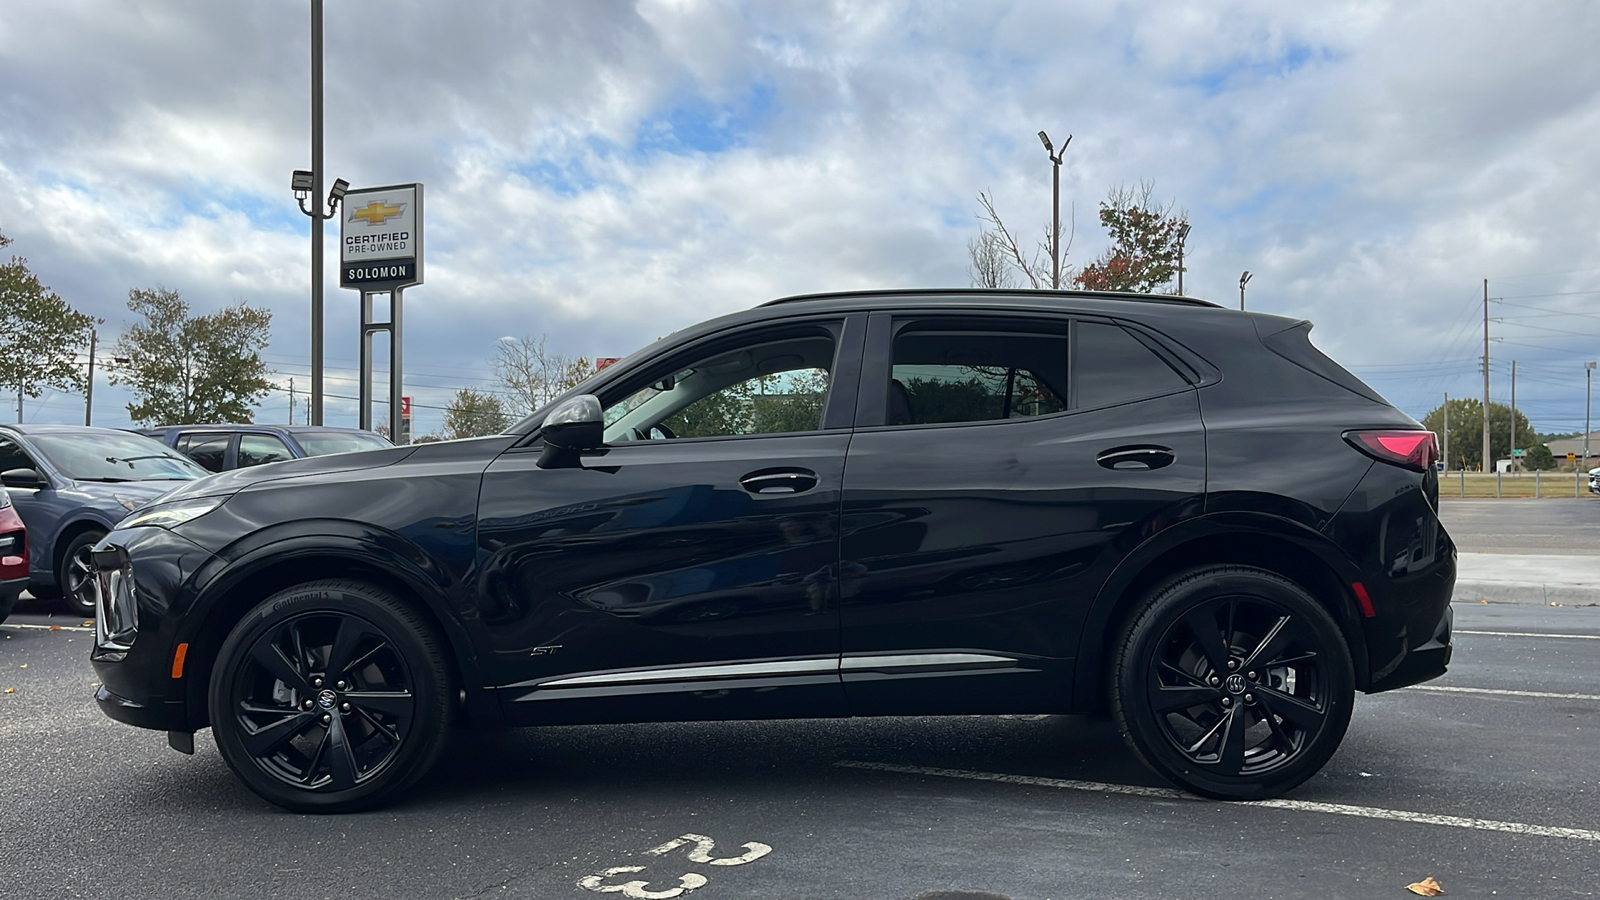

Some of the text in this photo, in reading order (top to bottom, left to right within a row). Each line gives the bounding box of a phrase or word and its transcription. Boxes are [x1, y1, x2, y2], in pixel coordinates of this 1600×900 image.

[346, 231, 409, 245] CERTIFIED
[348, 241, 406, 254] PRE-OWNED
[348, 265, 406, 280] SOLOMON
[273, 591, 322, 611] Continental
